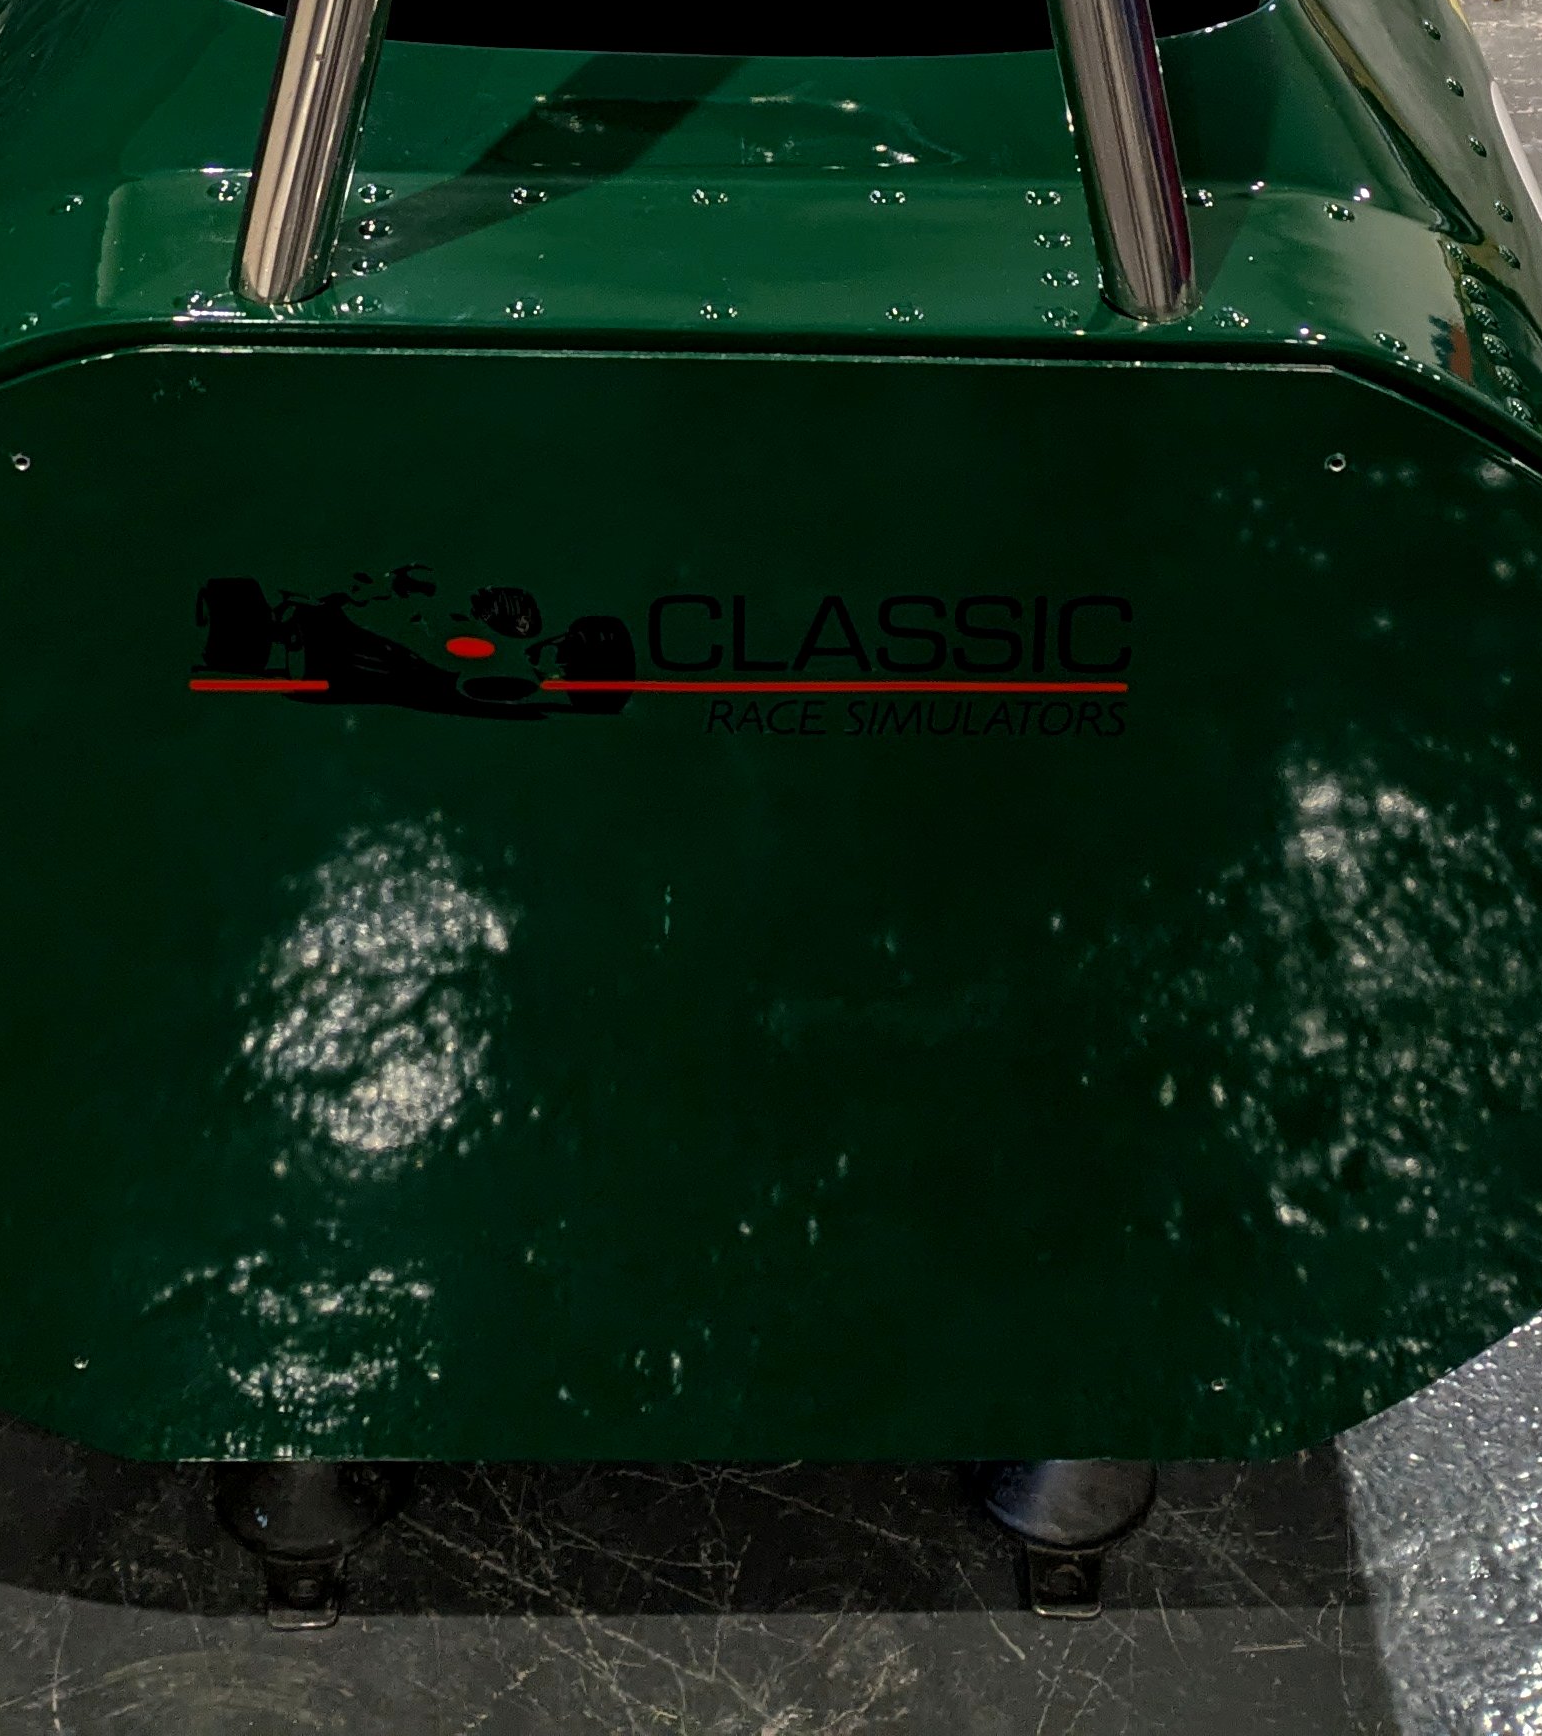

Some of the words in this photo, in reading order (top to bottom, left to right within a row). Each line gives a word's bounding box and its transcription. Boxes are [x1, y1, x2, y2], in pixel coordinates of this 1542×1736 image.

[647, 594, 1134, 674] CLASSIC
[705, 698, 827, 737] RACE
[844, 698, 1128, 738] SIMULATORS
